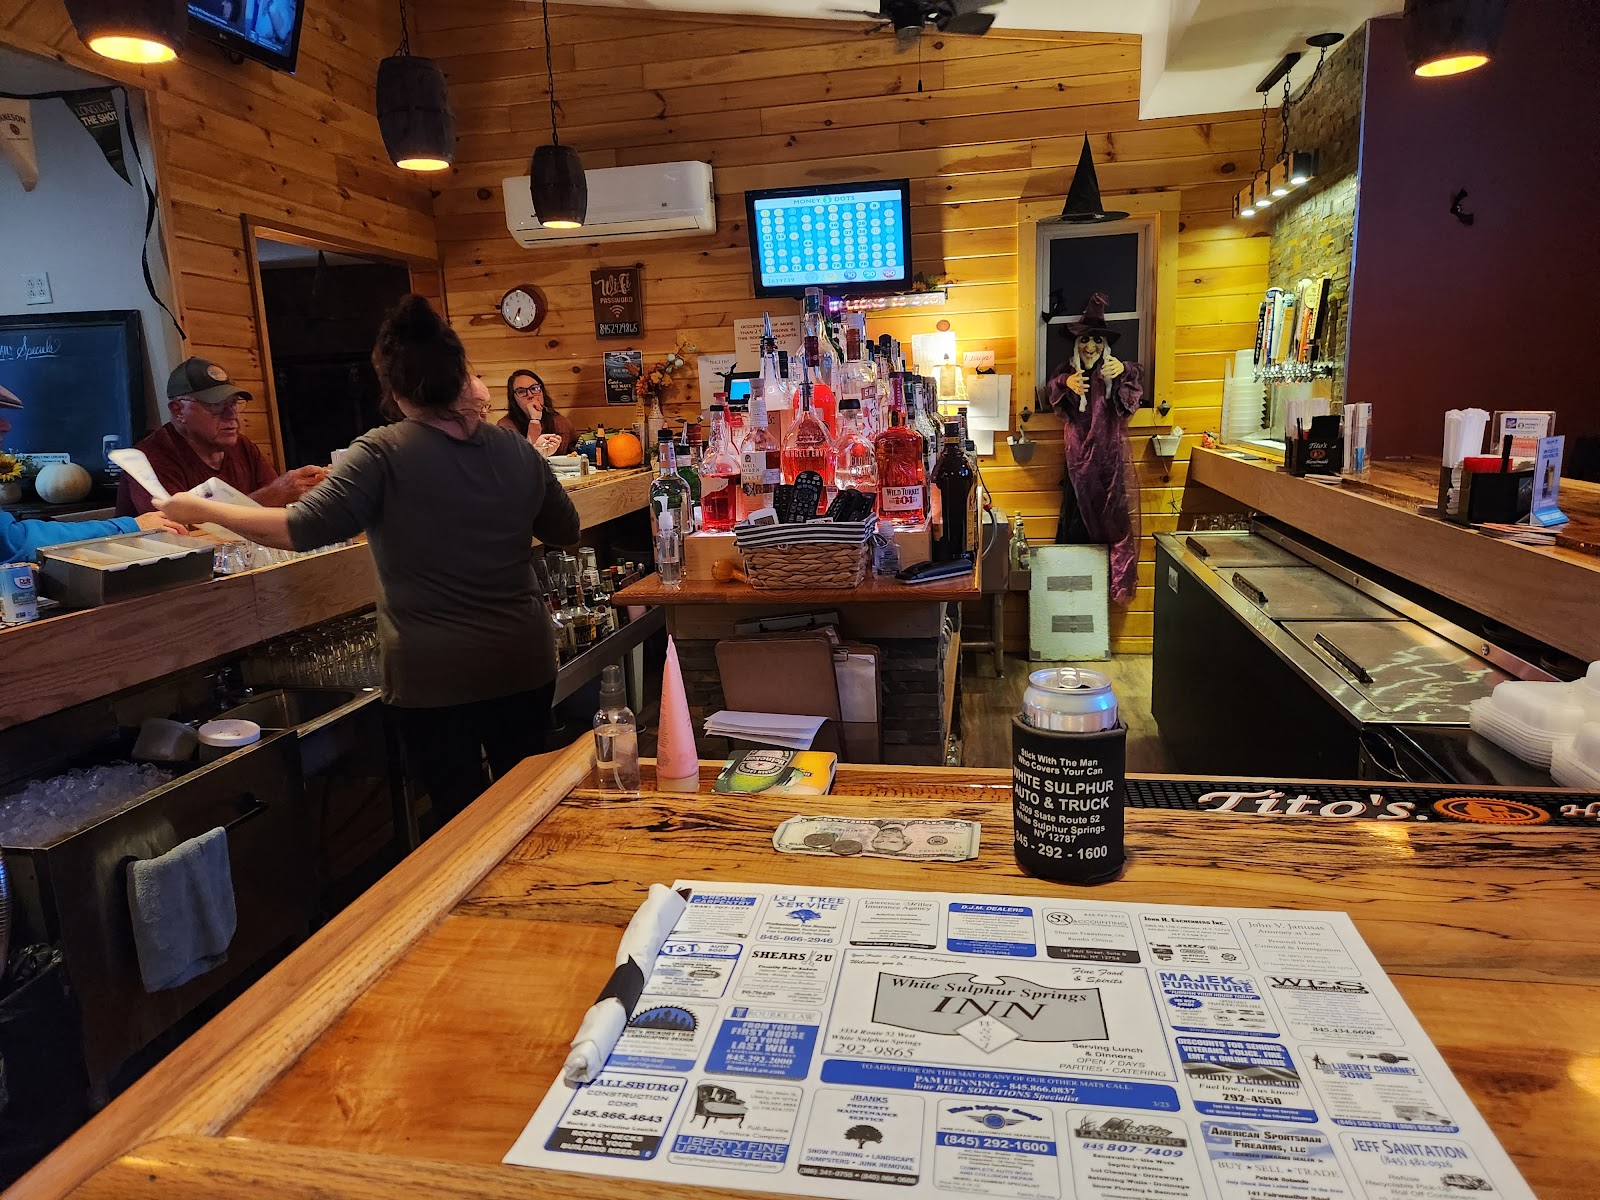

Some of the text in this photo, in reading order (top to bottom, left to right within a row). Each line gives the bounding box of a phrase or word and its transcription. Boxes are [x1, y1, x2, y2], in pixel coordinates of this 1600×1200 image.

[75, 101, 115, 117] LONG LIVE
[81, 111, 118, 126] THE SHOT
[600, 296, 633, 304] PASSWORD
[1308, 442, 1328, 450] Tito's
[895, 495, 913, 505] 101
[1020, 747, 1098, 767] Stick With The Man
[1018, 754, 1103, 776] Who Covers Your Can
[1013, 764, 1114, 795] WHITE SULPHUR
[1014, 783, 1110, 812] AUTO & TRUCK
[1016, 808, 1105, 836] White Sulphur Springs
[1033, 809, 1056, 823] State
[1059, 815, 1088, 824] Route
[1090, 814, 1101, 824] 52
[1033, 828, 1076, 844] NY 12787
[1037, 842, 1063, 859] 292
[1077, 845, 1108, 860] 1600
[752, 950, 833, 962] SHEARS 2U
[1098, 968, 1124, 976] Food
[1159, 972, 1238, 985] MAJEK
[892, 978, 1088, 1003] White Sulphur Springs
[1162, 981, 1255, 993] FURNITURE
[929, 996, 1048, 1021] INN
[730, 1027, 805, 1040] FIRST HOUSE
[742, 1022, 798, 1032] FROM YOUR
[730, 1041, 795, 1054] LAST WILL
[744, 1035, 787, 1046] TO YOUR
[856, 1036, 890, 1044] Sulphur
[892, 1038, 922, 1047] Springs
[835, 1043, 914, 1059] 292-9865
[1072, 1043, 1143, 1054] Serving Lunch
[1076, 1057, 1107, 1065] OPEN
[1117, 1060, 1146, 1068] DAYS
[1332, 1062, 1417, 1075] LIBERTY CHIMNEY
[1059, 1063, 1167, 1077] PARTIES CATERING
[1338, 1071, 1373, 1080] SONS
[915, 1075, 941, 1084] PAM
[944, 1077, 1000, 1088] HENNING
[586, 1089, 669, 1101] CONSTRUCTION
[850, 1094, 888, 1103] JBANKS
[936, 1085, 965, 1093] REAL
[967, 1087, 1031, 1099] SOLUTIONS
[1033, 1092, 1080, 1103] Specialist
[836, 1108, 898, 1117] MAINTENANCE
[1210, 1127, 1322, 1144] AMERICAN SPORTSMAN
[676, 1136, 788, 1154] LIBERTY FINE
[944, 1134, 1049, 1152] (845) 292-1600
[1082, 1142, 1184, 1158] 845 807-7409
[1234, 1139, 1306, 1153] FIREARMS, LLC
[1351, 1137, 1469, 1160] JEFF SANITATION
[674, 1145, 785, 1160] UPHOLSTERY
[830, 1150, 864, 1159] PLOWING
[871, 1154, 915, 1163] LANDSCAPE
[805, 1156, 914, 1171] DUMPSTERS JUNK REMOVAL
[1107, 1162, 1130, 1170] Septic
[1217, 1161, 1340, 1178] BUY SELL TRADE
[1087, 1175, 1124, 1184] Retaining
[1153, 1181, 1190, 1190] Drainage
[1388, 1174, 1420, 1182] Refuse
[1114, 1185, 1145, 1194] Plowing
[1154, 1189, 1189, 1197] Removal
